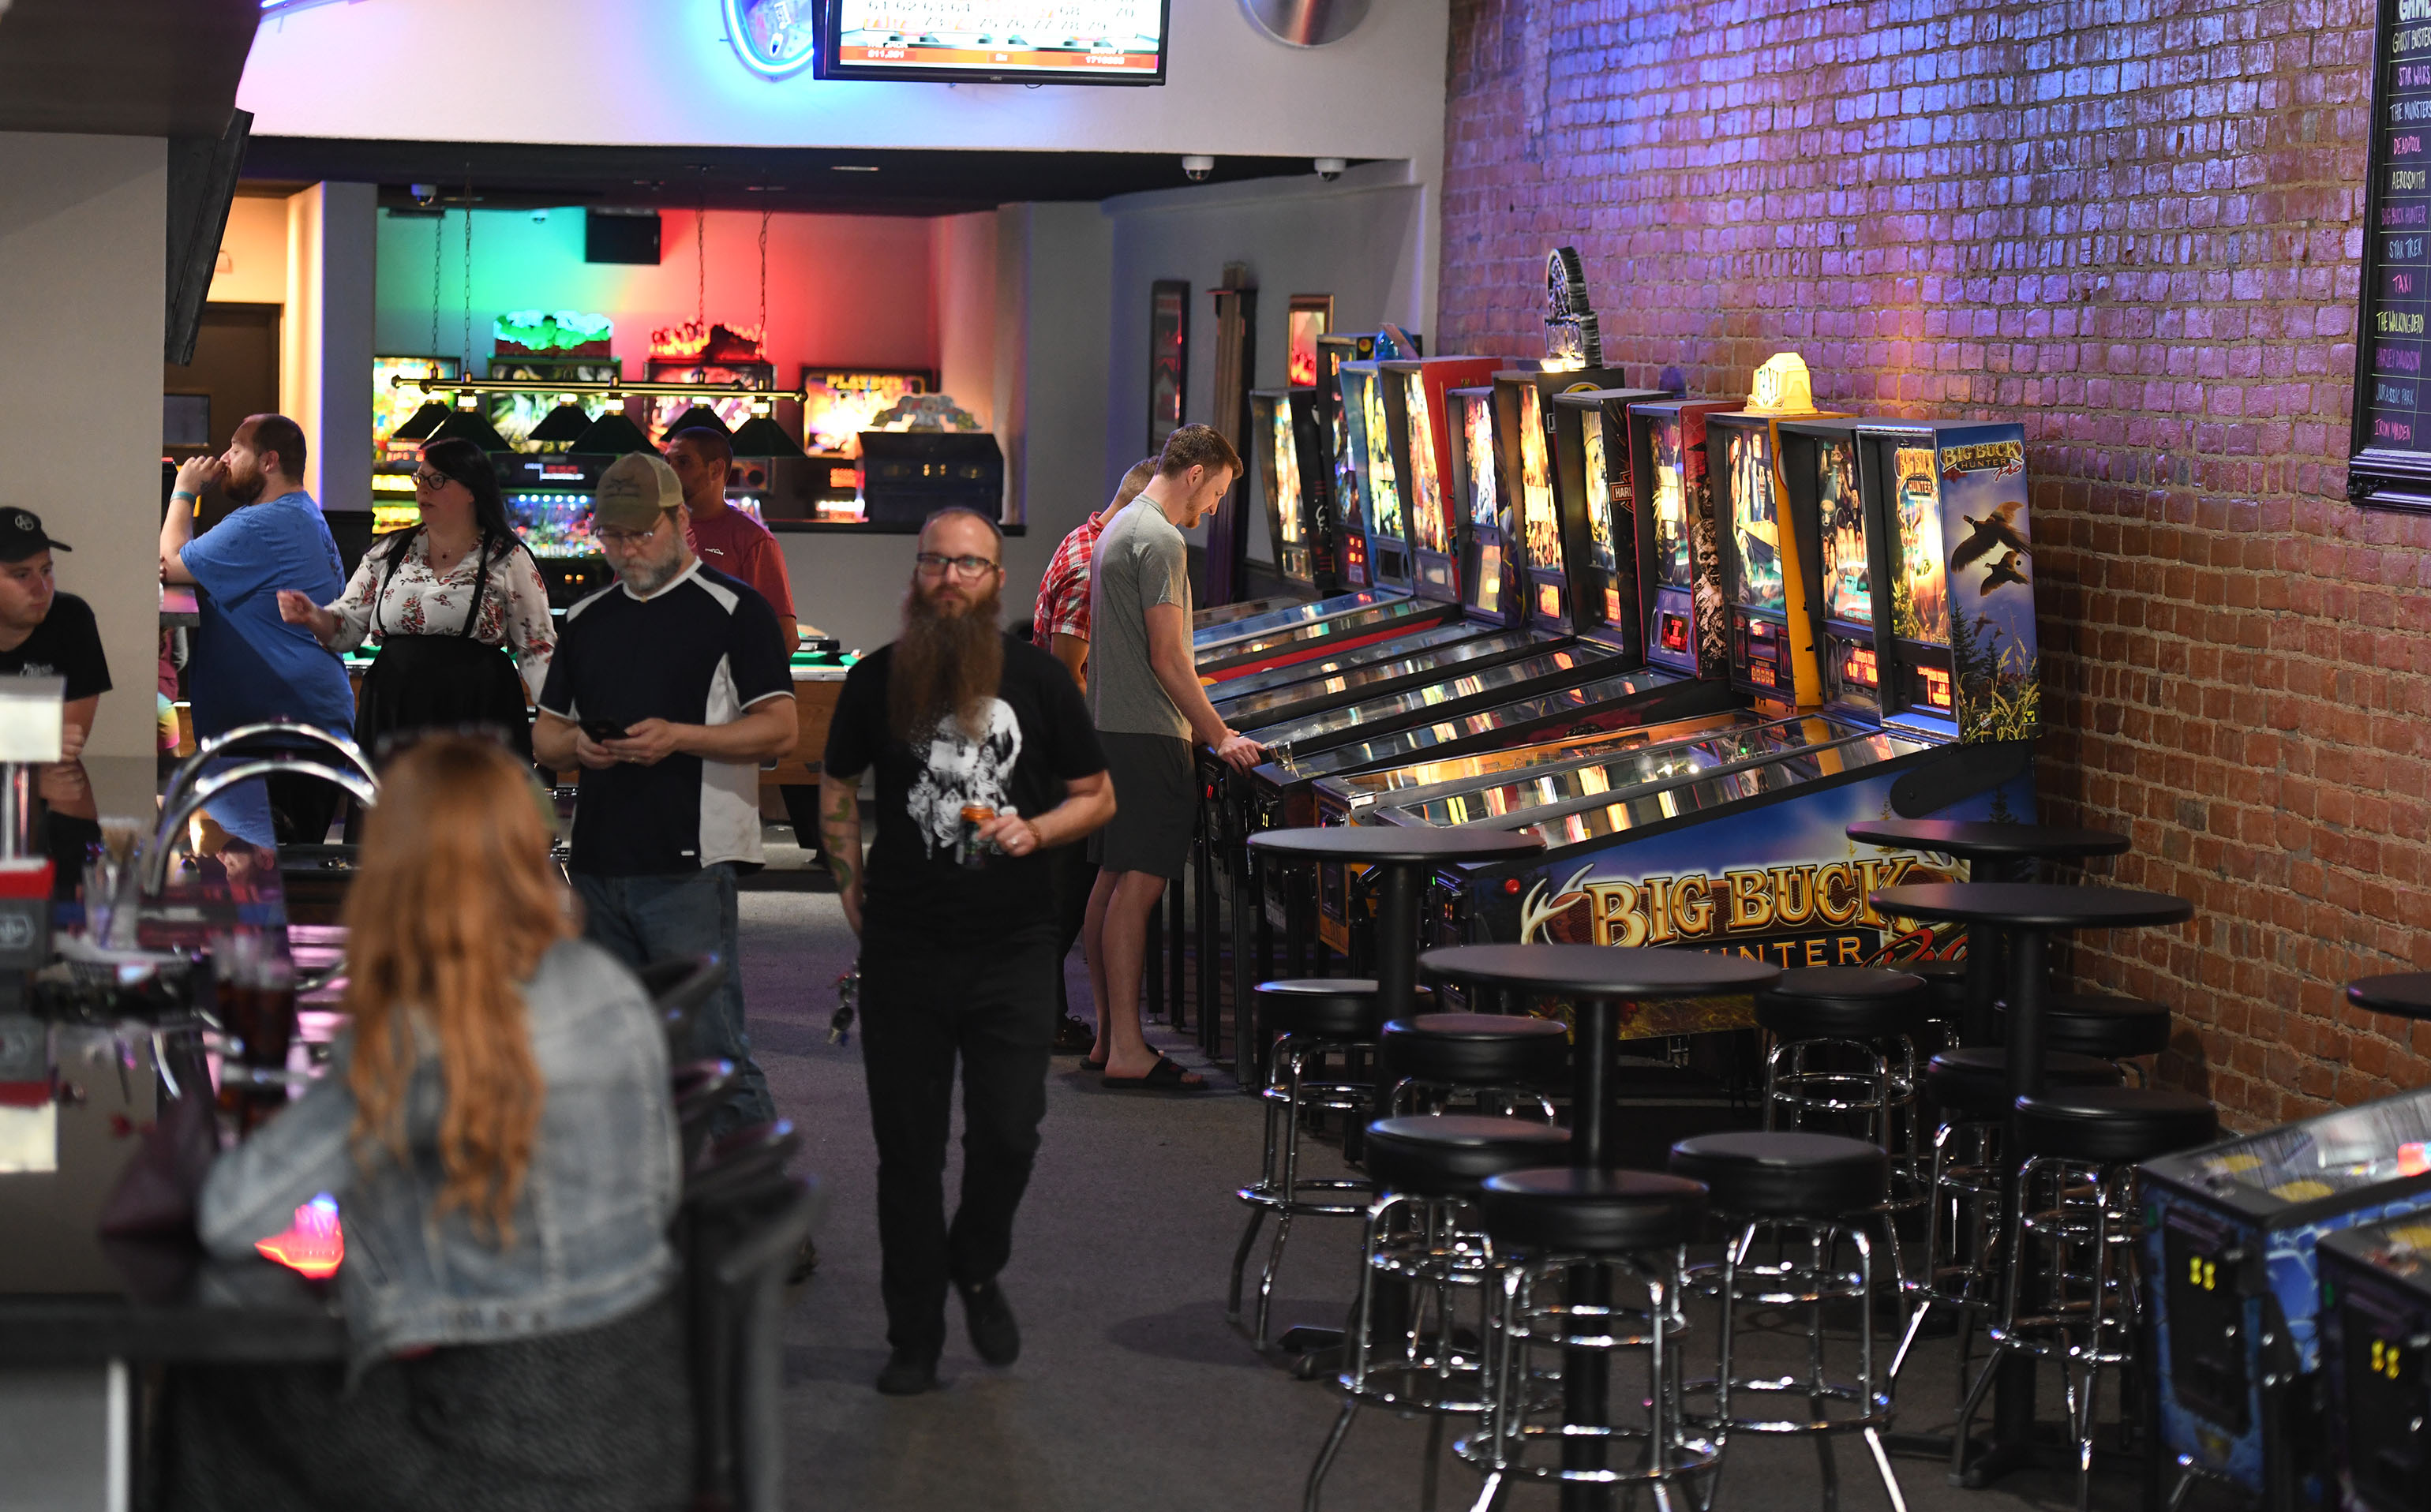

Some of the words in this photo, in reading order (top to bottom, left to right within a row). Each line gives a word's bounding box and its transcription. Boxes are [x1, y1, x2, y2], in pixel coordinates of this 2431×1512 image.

[2398, 66, 2412, 86] STAR
[2413, 65, 2431, 86] WARS
[2389, 103, 2403, 122] THE
[2394, 135, 2422, 155] DEADPOOL
[2392, 170, 2425, 190] AEROSMITH
[2392, 208, 2404, 225] BUCK
[2389, 240, 2405, 259] STAR
[2405, 237, 2422, 259] TREK
[2392, 273, 2412, 294] TAXI
[2376, 311, 2388, 331] THE
[2388, 310, 2410, 334] WALKING
[2411, 313, 2424, 335] DEAD
[2401, 384, 2414, 406] PARK
[2390, 421, 2411, 440] MAIDEN
[1942, 446, 1975, 471] BIG
[1975, 440, 2023, 463] BUCK
[1961, 458, 2008, 470] HUNTER
[1993, 462, 2023, 481] Pro
[1908, 480, 1931, 493] HUNTER
[1583, 874, 1715, 948] BIG
[1725, 855, 1920, 936] BUCK
